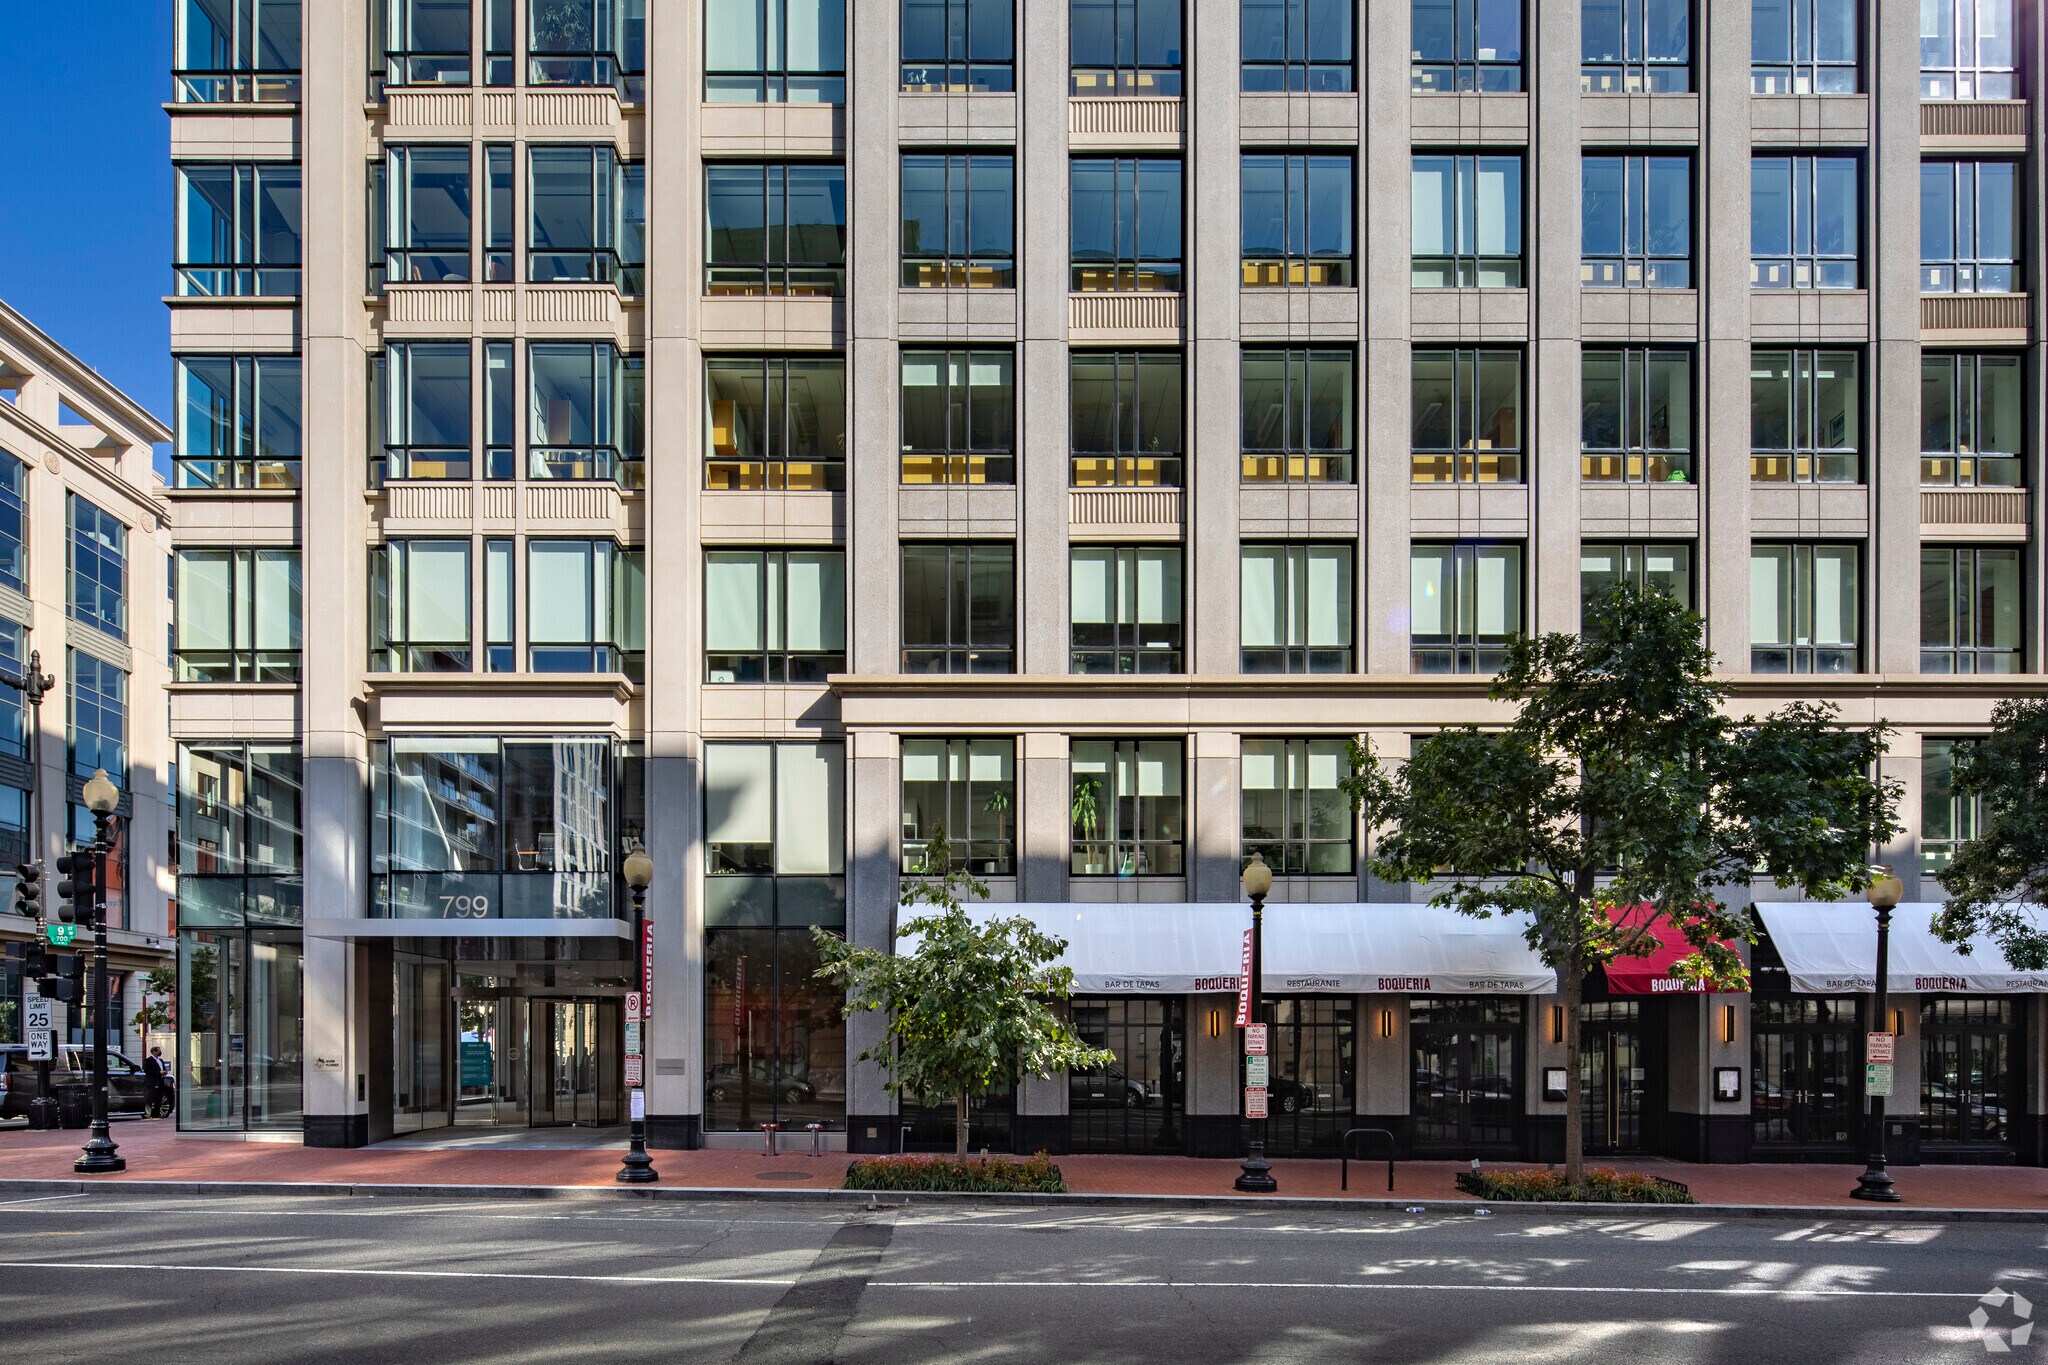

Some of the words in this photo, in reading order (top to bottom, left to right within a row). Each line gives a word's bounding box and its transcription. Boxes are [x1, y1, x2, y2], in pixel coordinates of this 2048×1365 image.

[439, 895, 489, 919] 799
[57, 926, 65, 936] 9
[645, 924, 654, 1017] BOQUERIA
[1104, 980, 1121, 988] BAR
[1123, 980, 1134, 988] DE
[1136, 980, 1160, 988] TAPAS
[1195, 977, 1240, 991] BOQUERI
[1235, 932, 1250, 1025] BOQUERIA
[1286, 979, 1341, 988] RESTAURANTE
[1378, 977, 1431, 991] BOQUERIA
[1469, 981, 1485, 989] BAR
[1487, 980, 1498, 988] DE
[1500, 981, 1524, 989] TAPAS
[1826, 980, 1843, 988] BAR
[1844, 979, 1855, 987] DE
[1856, 979, 1877, 987] TAPA
[1915, 977, 1967, 990] BOQUERIA
[28, 1013, 49, 1027] 25
[30, 1040, 48, 1048] WAY
